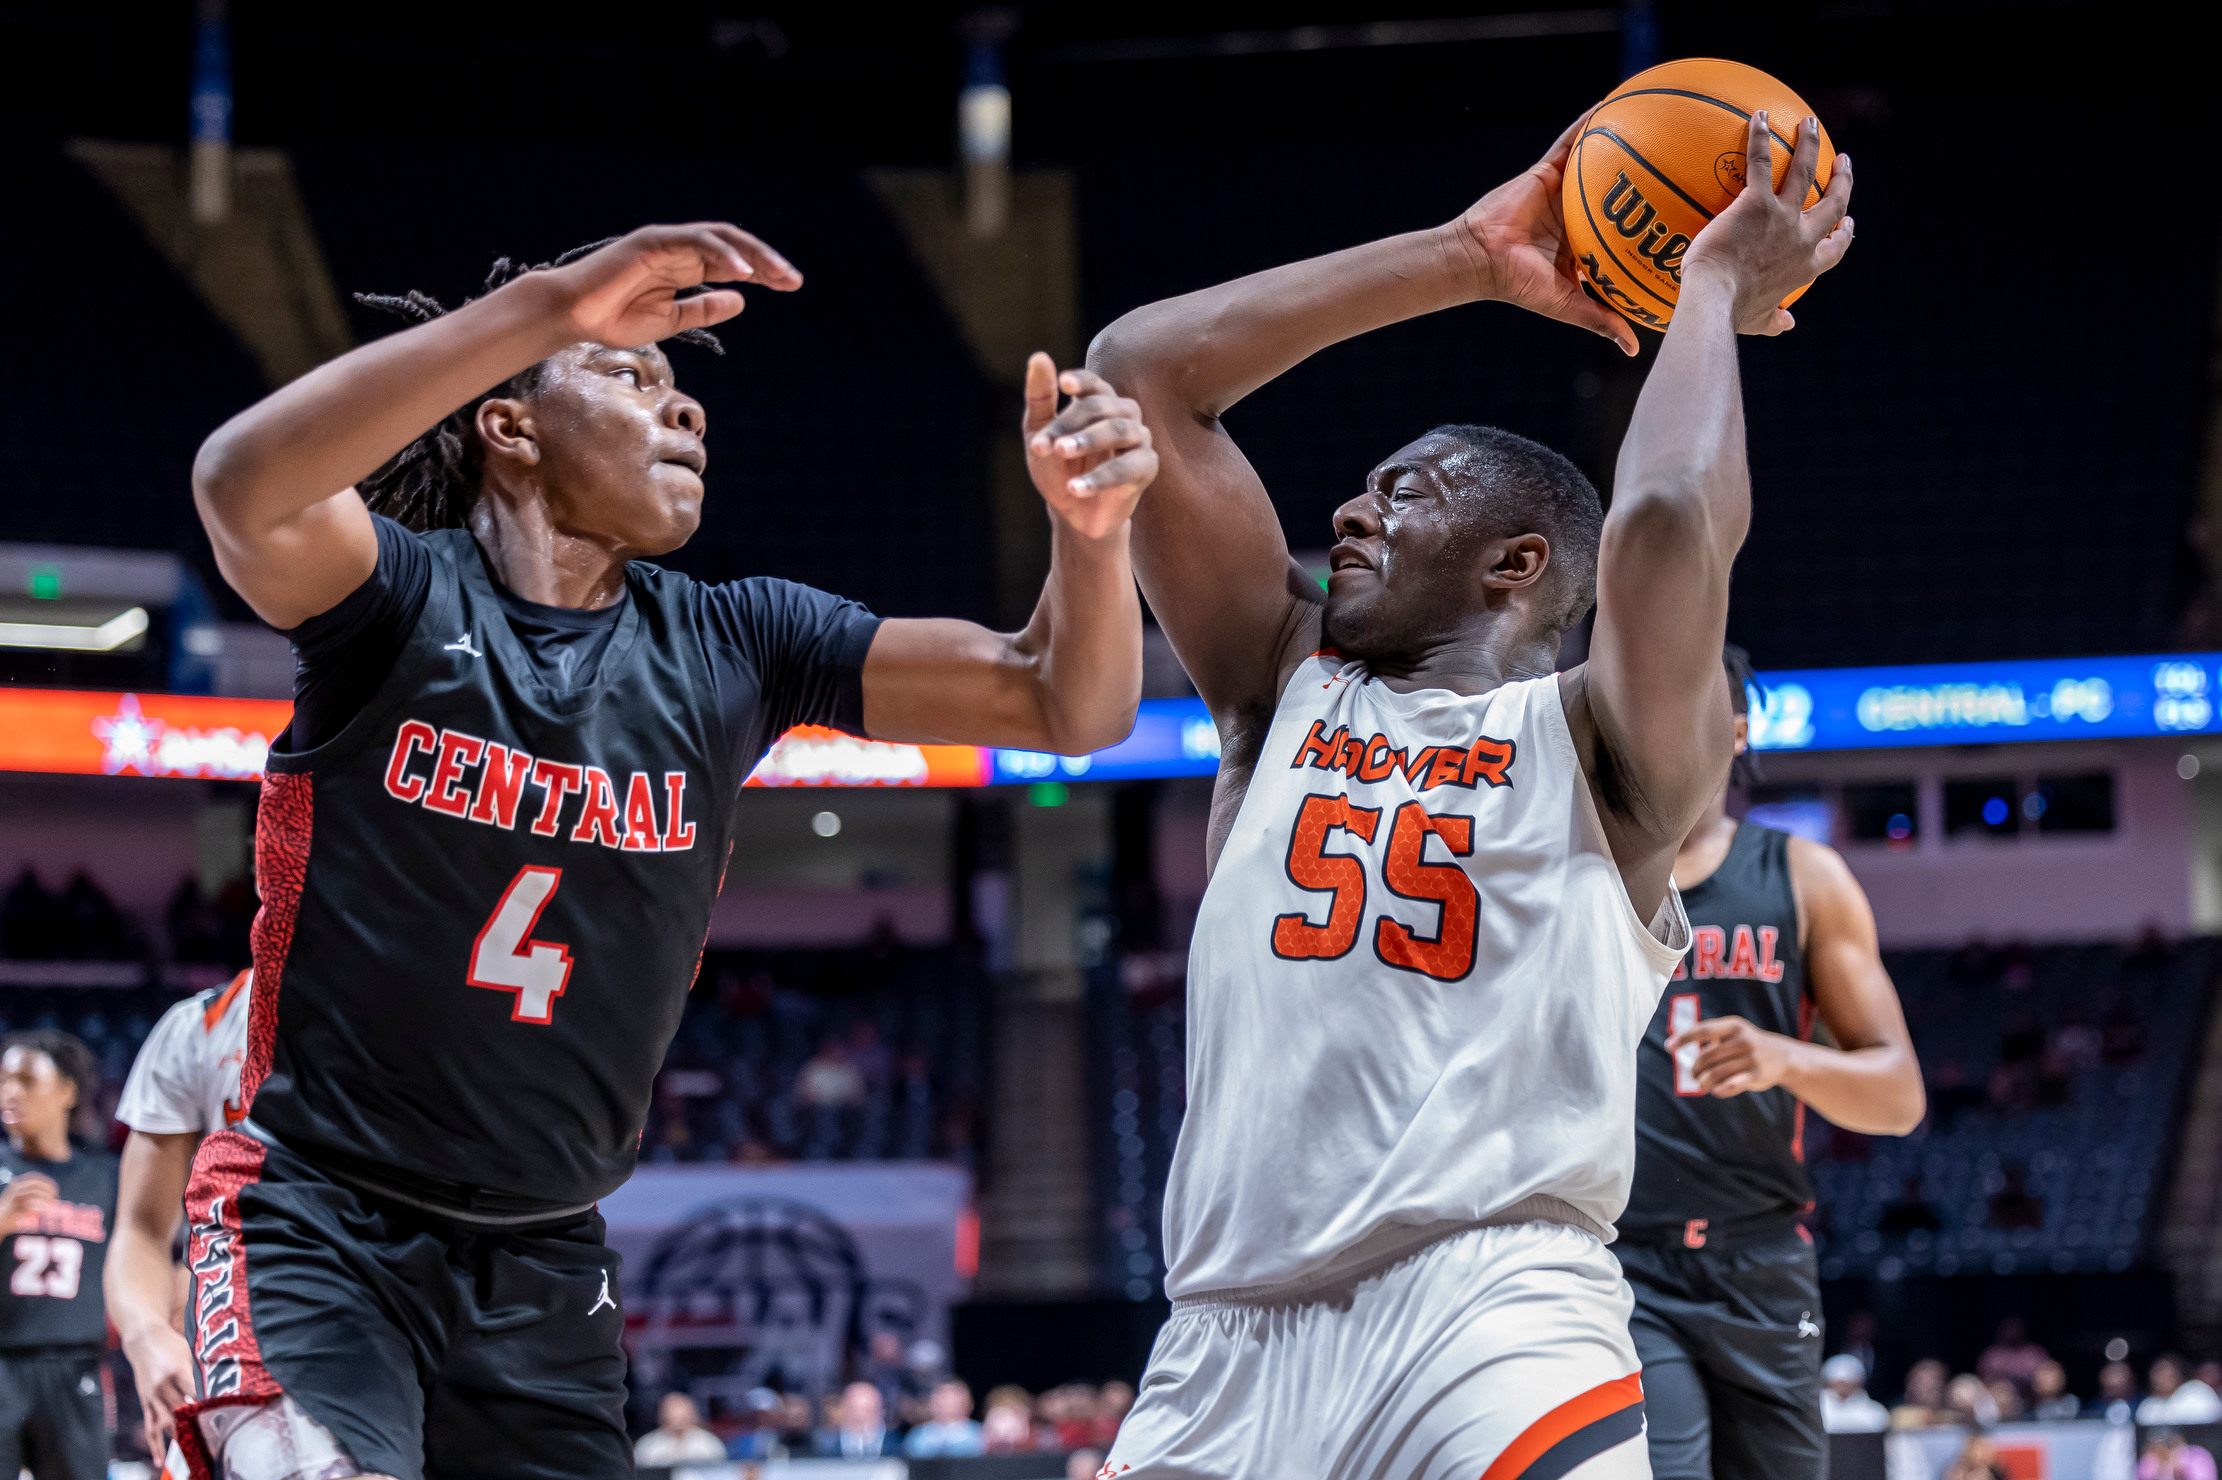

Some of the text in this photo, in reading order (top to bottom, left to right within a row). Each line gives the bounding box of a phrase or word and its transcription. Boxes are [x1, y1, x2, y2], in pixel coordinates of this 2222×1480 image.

[1578, 252, 1671, 330] NCA
[1625, 248, 1677, 292] INDOOR GAME
[384, 719, 698, 852] CENTRAL
[1290, 719, 1514, 792] HOOVER
[1271, 792, 1481, 983] 55
[466, 864, 574, 1025] 4
[1671, 924, 1785, 984] RAL
[1666, 992, 1708, 1097] 1
[10, 1235, 84, 1299] 23
[1683, 1218, 1709, 1249] C
